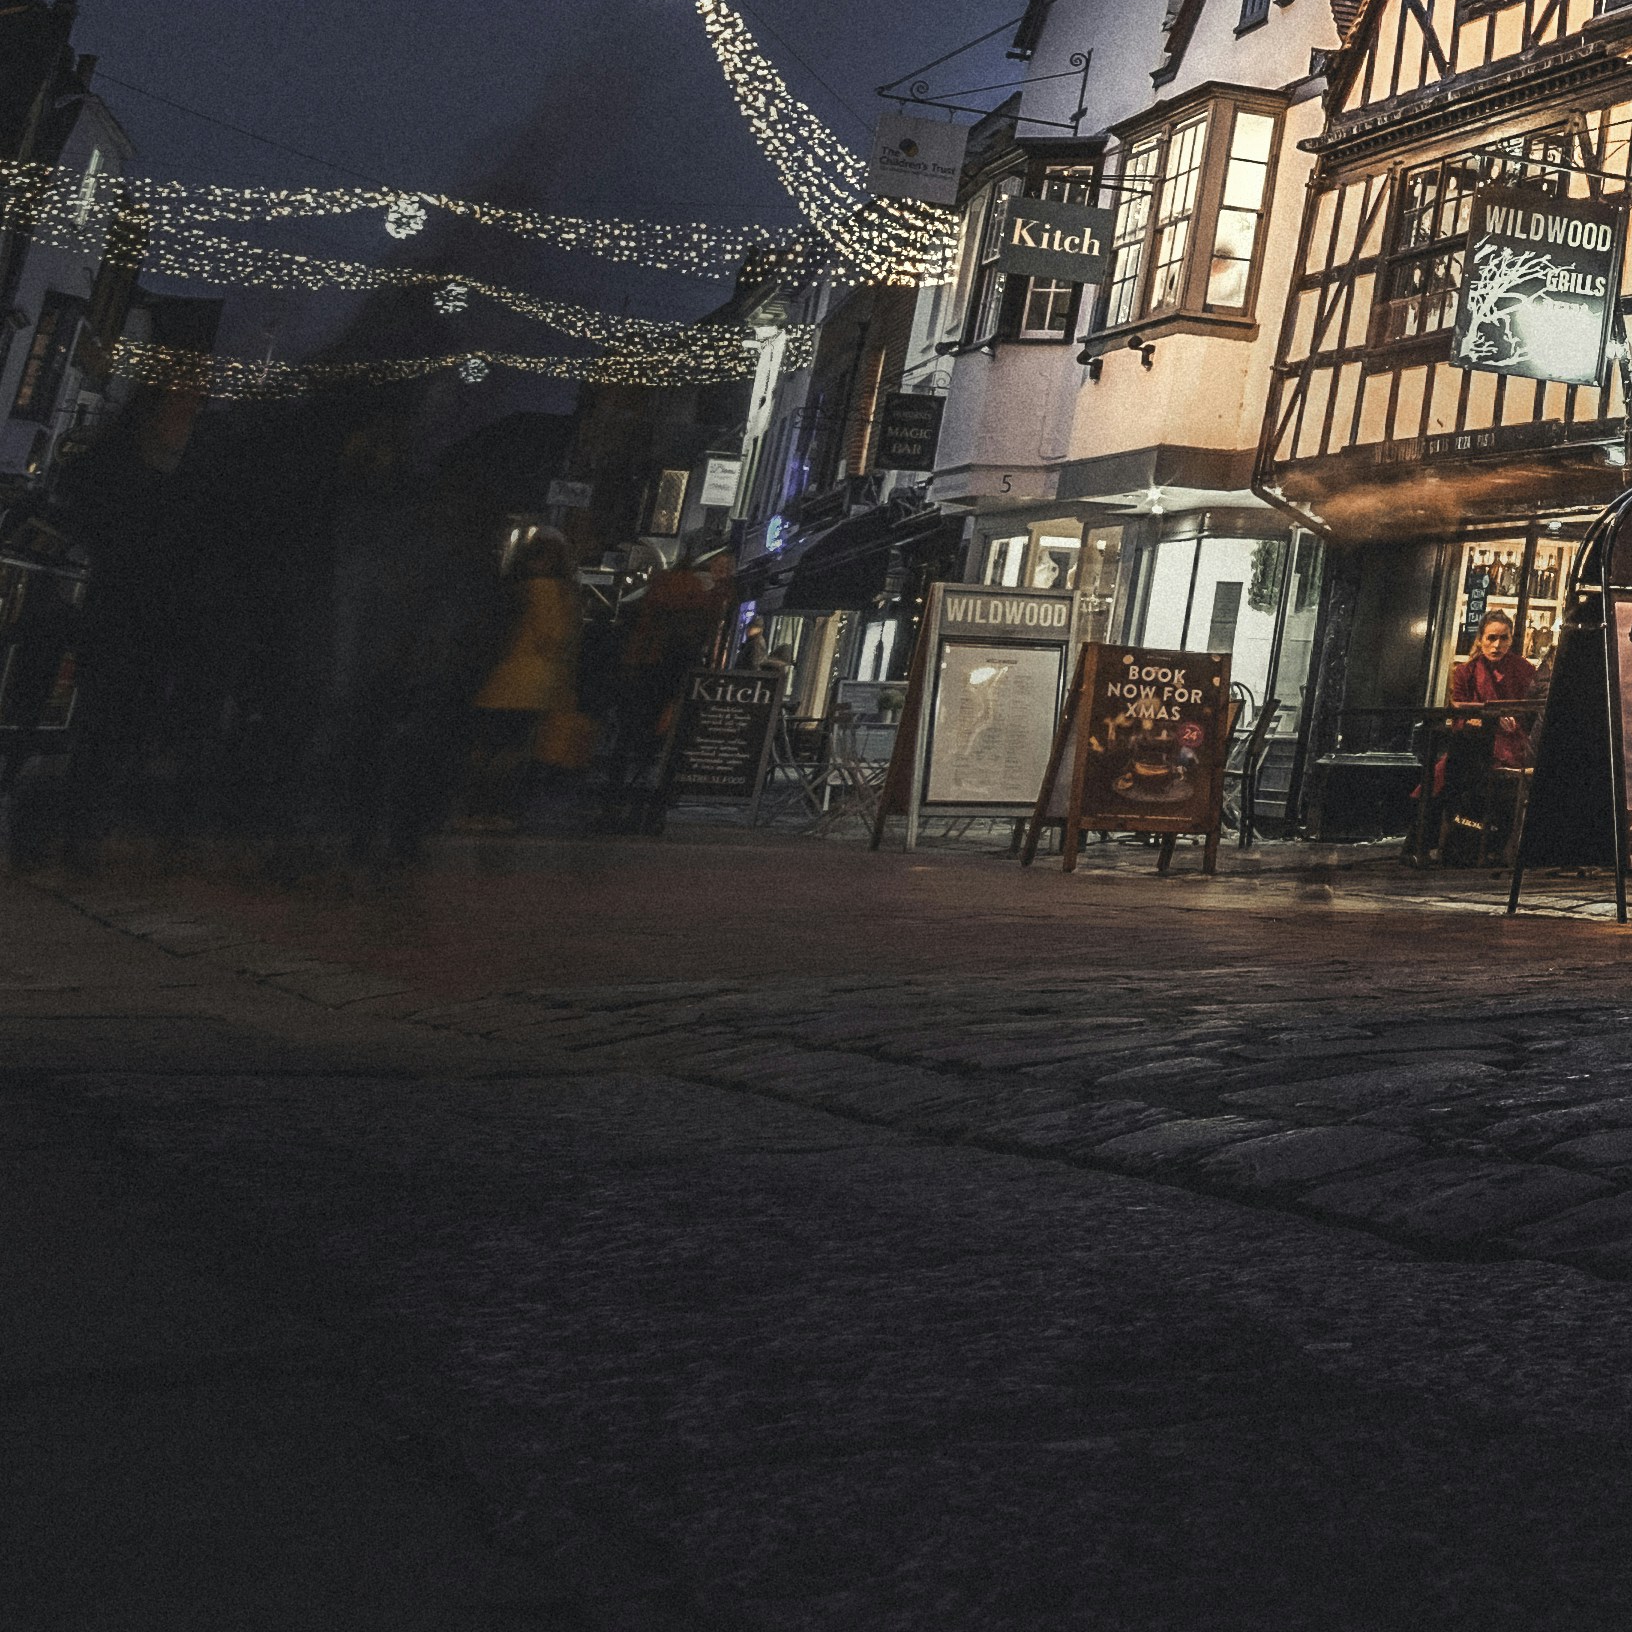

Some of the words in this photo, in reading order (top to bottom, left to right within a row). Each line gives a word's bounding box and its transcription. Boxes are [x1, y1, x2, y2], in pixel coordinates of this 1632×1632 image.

[1010, 217, 1100, 256] Kitch
[1486, 204, 1612, 252] WILDWOOD
[1545, 270, 1607, 297] GRILLS
[887, 427, 933, 439] MAGIC
[1000, 474, 1012, 493] 5
[946, 597, 1067, 628] WILDWOOD
[1128, 665, 1187, 685] BOOK
[691, 677, 771, 705] Kitch
[1107, 682, 1156, 700] NOW
[1163, 686, 1203, 704] FOR
[1125, 702, 1181, 721] XMAS
